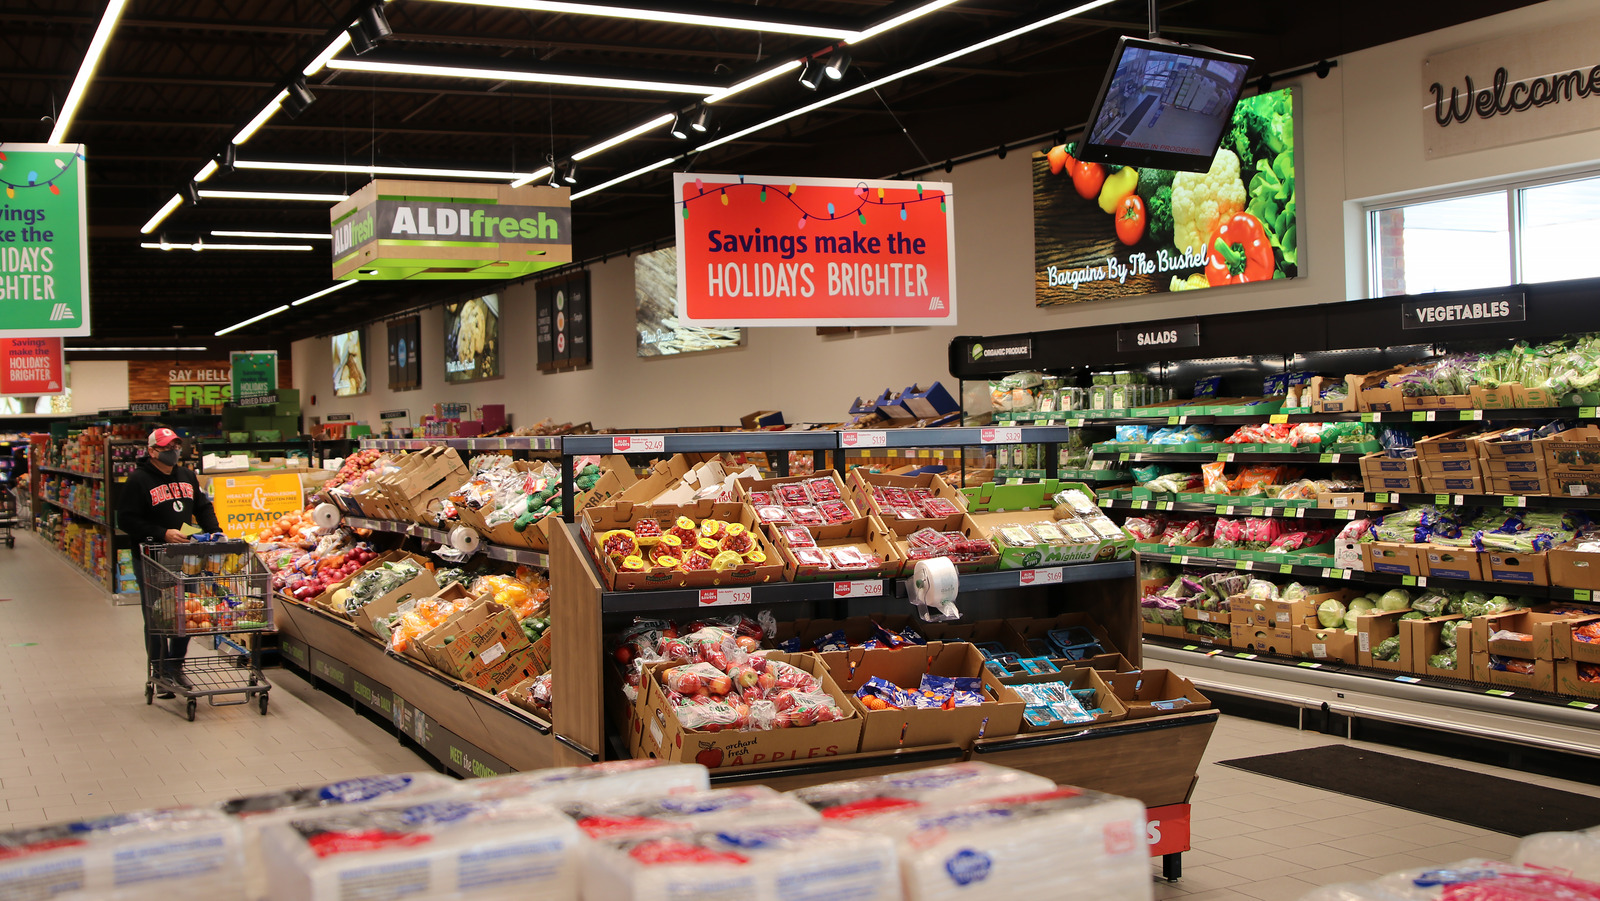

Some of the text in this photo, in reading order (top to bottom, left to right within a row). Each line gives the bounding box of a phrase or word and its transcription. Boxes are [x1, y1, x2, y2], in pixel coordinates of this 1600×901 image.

[1429, 65, 1600, 127] Welcome
[391, 207, 558, 239] ALDIfresh
[21, 226, 54, 242] the
[334, 210, 374, 255] ALDIfresh
[708, 228, 926, 259] Savings make the
[0, 246, 53, 272] IDAYS
[1047, 243, 1209, 290] Bargains By The Bushel
[708, 261, 929, 297] HOLIDAYS BRIGHTER
[1416, 301, 1510, 323] VEGETABLES
[12, 338, 46, 347] Savings
[1137, 330, 1177, 346] SALADS
[984, 346, 1027, 357] ORGANIC PRODUCE
[10, 356, 50, 368] HOLIDAYS
[10, 369, 51, 381] BRIGHTER
[169, 369, 192, 381] SAY
[131, 403, 167, 411] VEGETABLES
[644, 441, 663, 449] $2.49
[251, 487, 270, 511] &
[228, 522, 255, 531] HAVE
[1044, 552, 1092, 562] Mighties
[1047, 572, 1062, 581] $1.69
[864, 585, 882, 594] $2.69
[733, 592, 751, 602] $1.29
[725, 737, 757, 750] orchard
[728, 747, 750, 758] fresh
[731, 745, 839, 767] APPLES
[449, 745, 498, 778] MEET the GROWE
